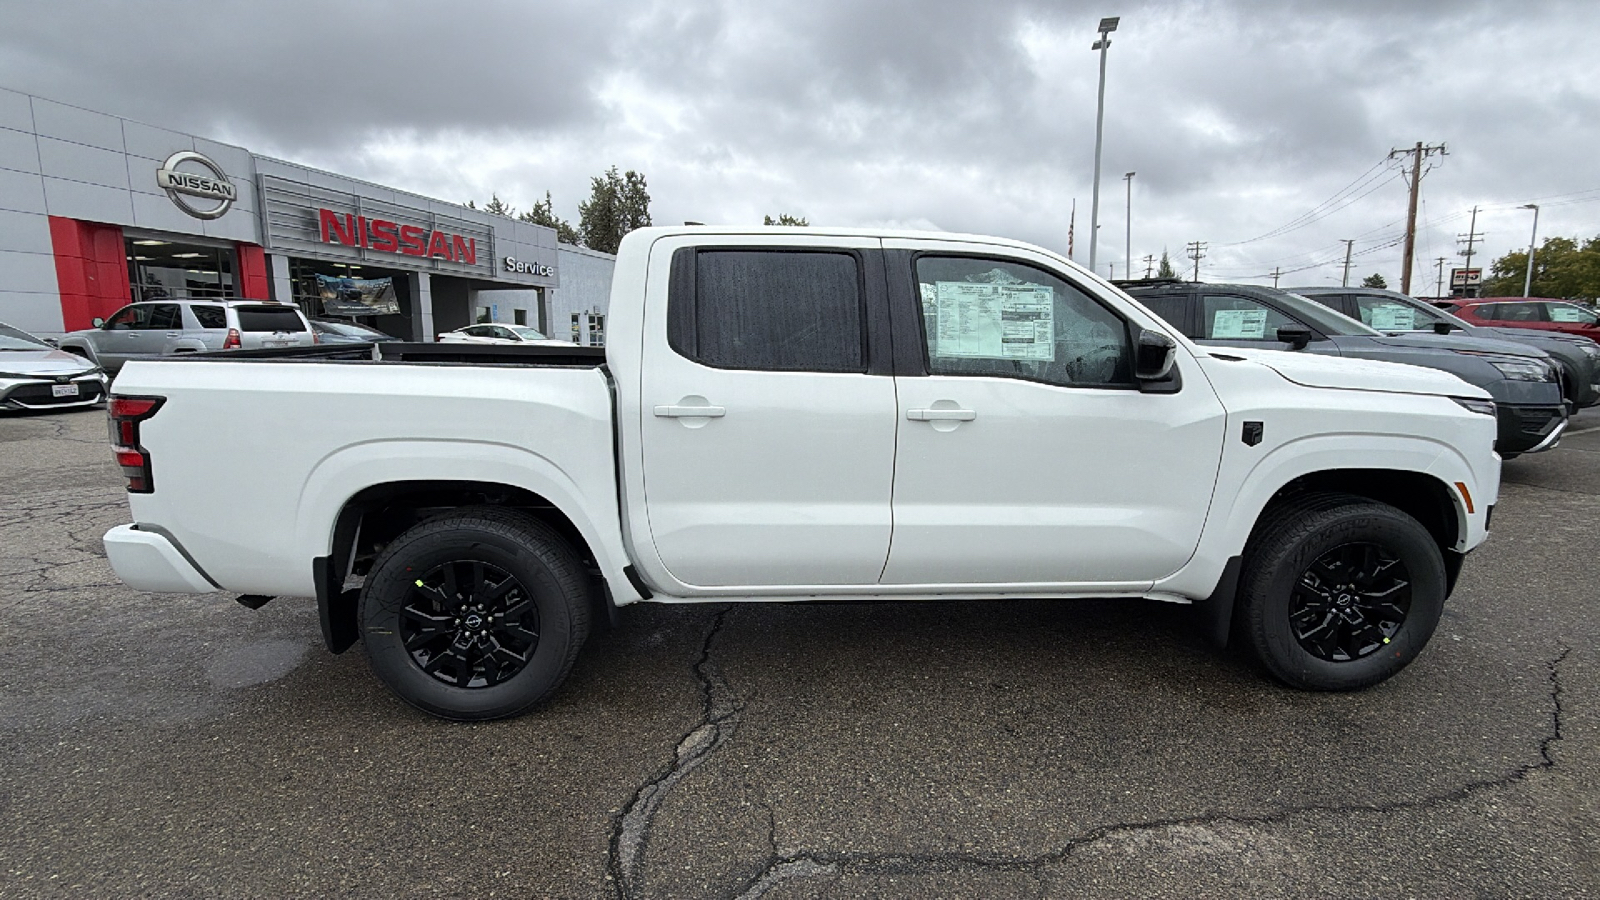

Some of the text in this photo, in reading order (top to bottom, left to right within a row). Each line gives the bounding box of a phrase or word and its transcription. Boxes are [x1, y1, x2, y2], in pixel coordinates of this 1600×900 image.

[168, 174, 232, 195] NISSAN
[319, 208, 477, 265] NISSAN
[506, 256, 554, 277] Service
